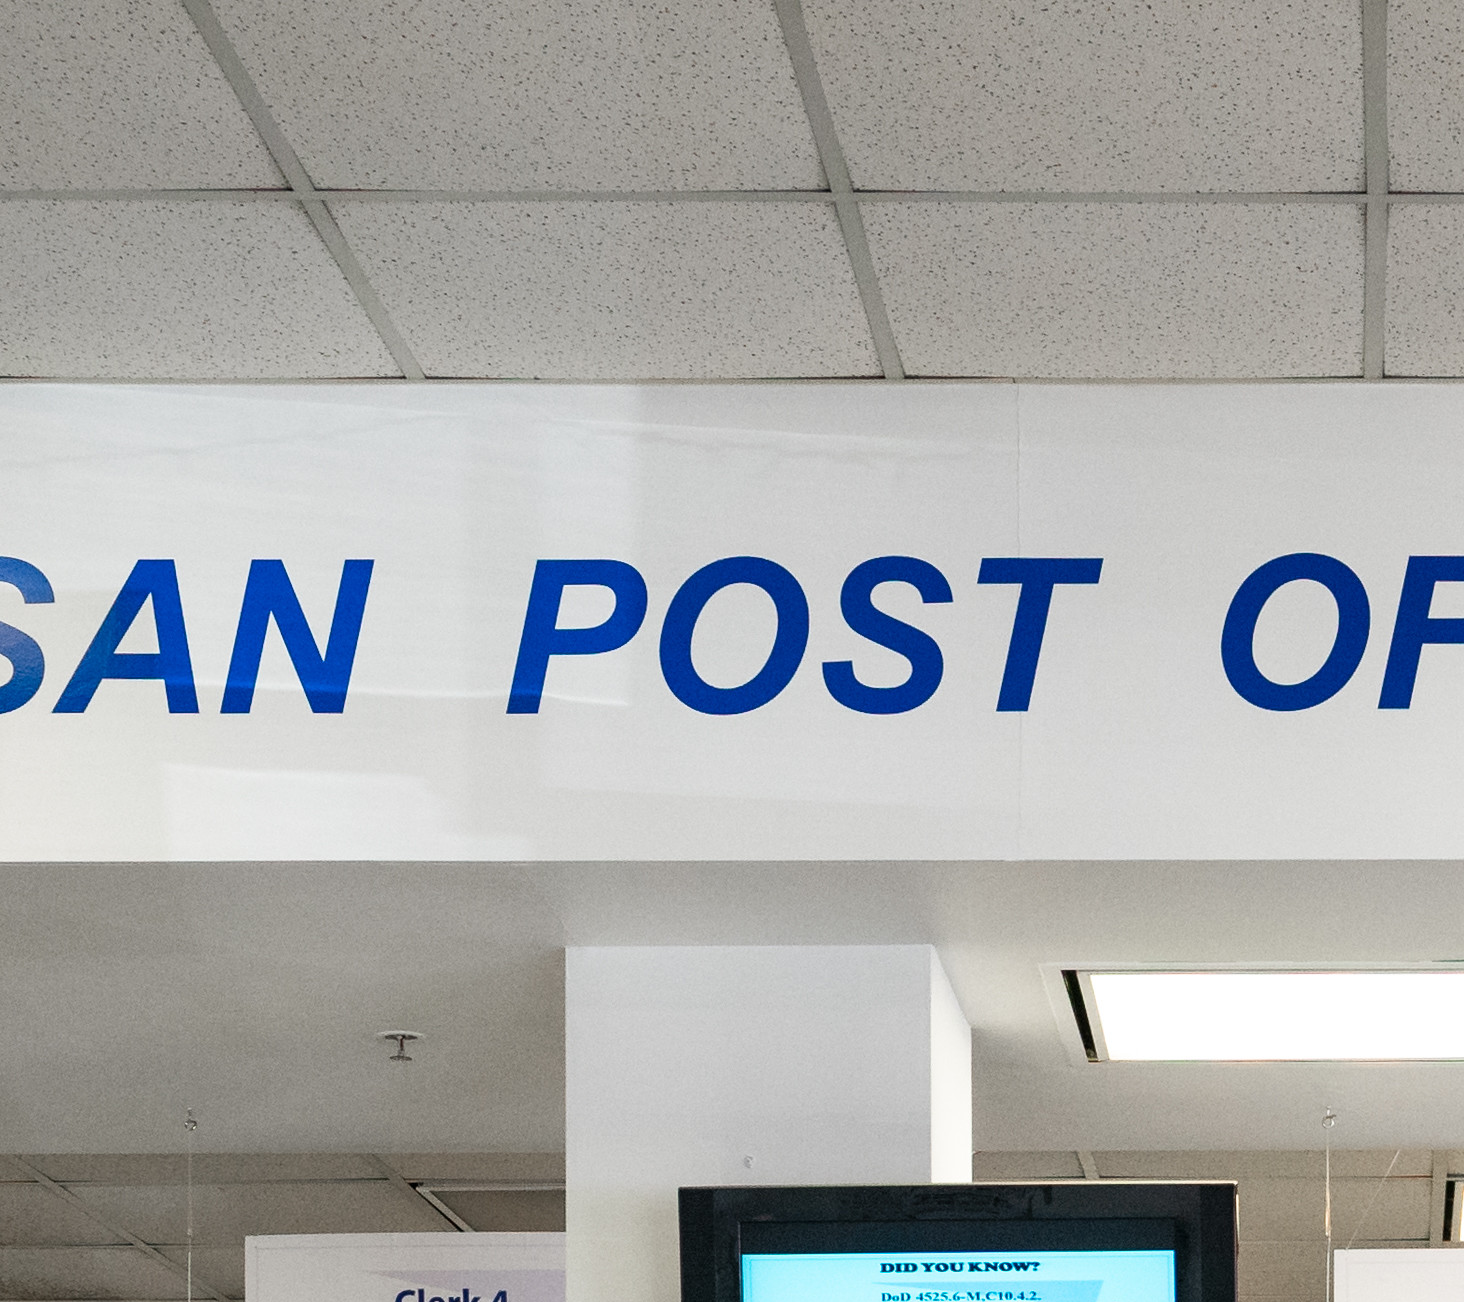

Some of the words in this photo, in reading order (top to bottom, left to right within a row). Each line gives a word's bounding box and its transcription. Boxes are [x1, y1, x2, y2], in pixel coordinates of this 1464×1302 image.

[505, 555, 1104, 716] POST
[879, 1262, 919, 1274] DID
[920, 1261, 965, 1273] YOU
[967, 1261, 1041, 1273] KNOW?
[881, 1292, 912, 1302] DoD
